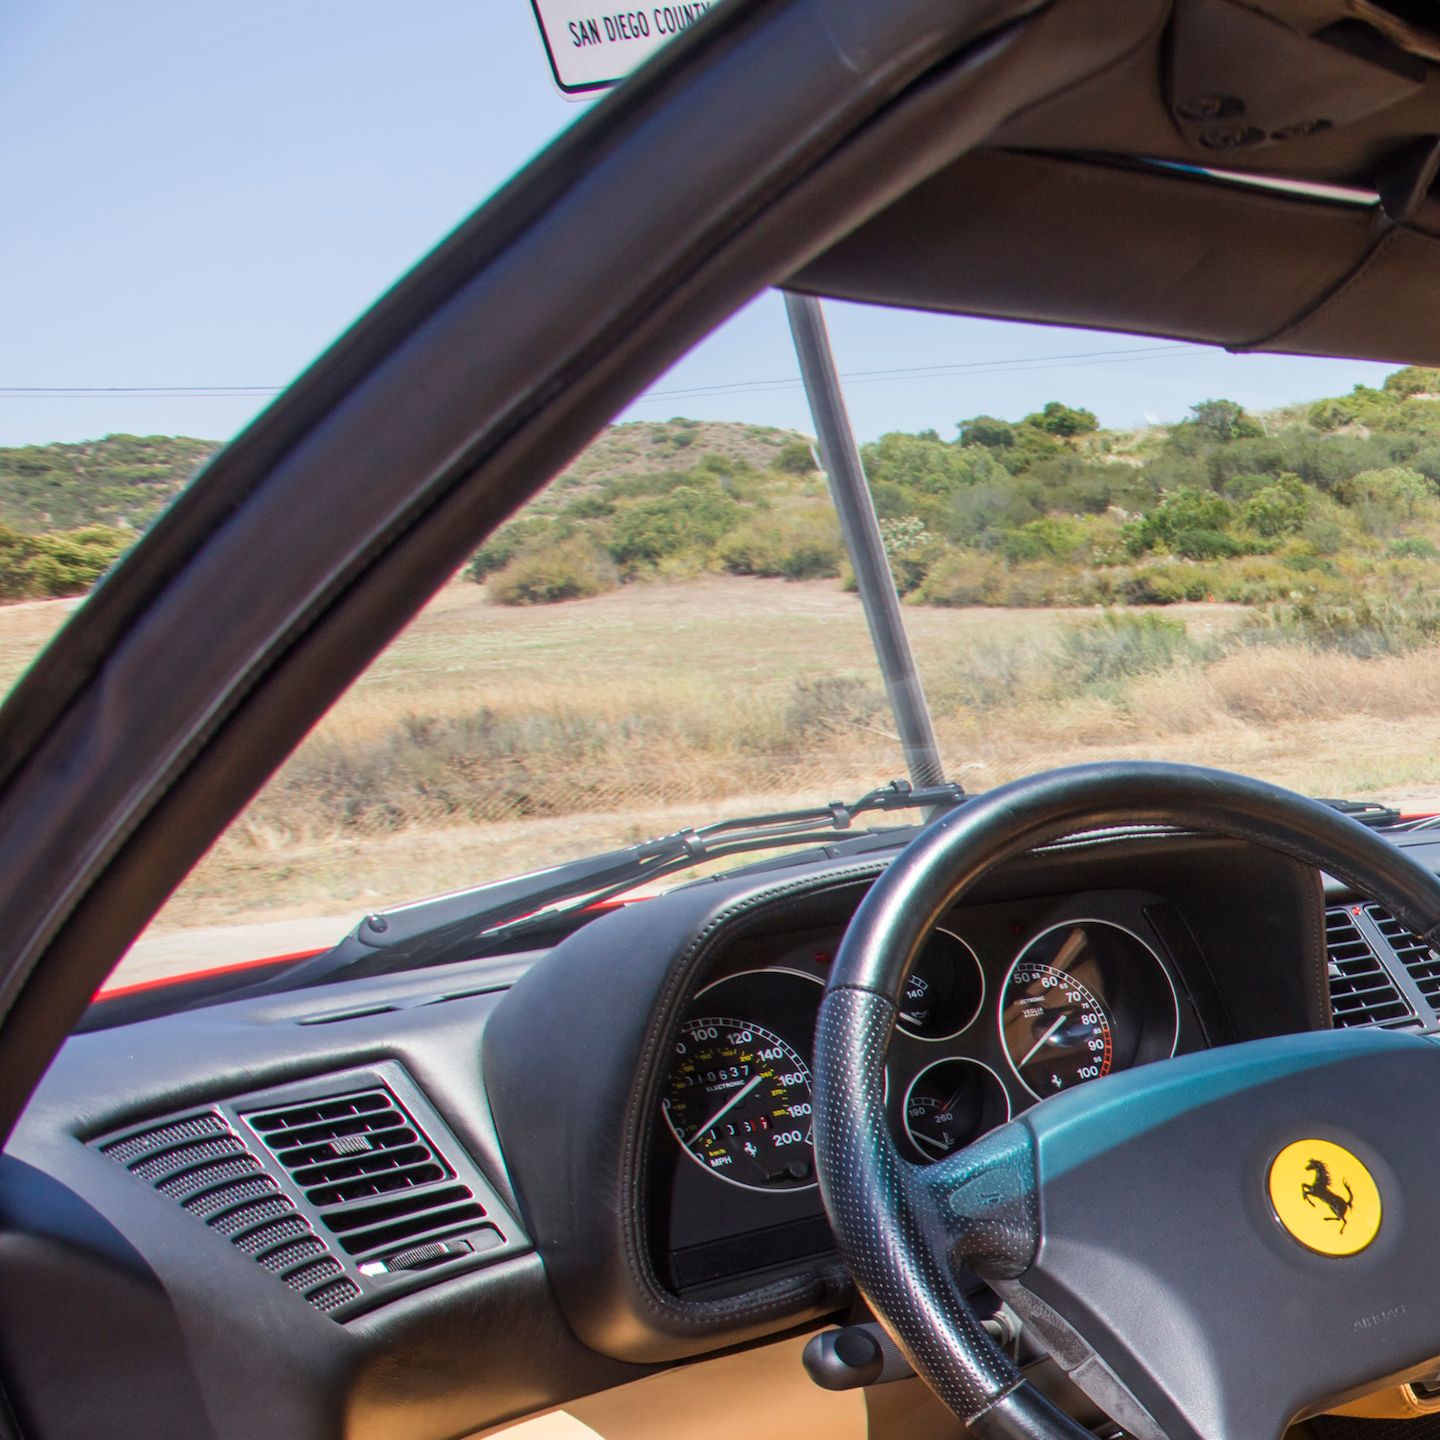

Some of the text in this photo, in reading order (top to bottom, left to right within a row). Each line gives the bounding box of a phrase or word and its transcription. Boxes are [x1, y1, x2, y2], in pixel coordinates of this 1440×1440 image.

[569, 18, 601, 47] SAN
[603, 11, 650, 42] DIEGO
[1041, 976, 1058, 988] 60
[906, 988, 924, 999] 140
[1065, 991, 1081, 1003] 70
[1081, 1013, 1098, 1025] 80
[691, 1027, 719, 1042] 100
[726, 1030, 752, 1046] 120
[1087, 1039, 1104, 1051] 90
[757, 1047, 784, 1062] 140
[779, 1072, 803, 1087] 160
[1077, 1066, 1099, 1079] 100
[787, 1103, 812, 1118] 180
[773, 1130, 802, 1147] 200
[710, 1156, 732, 1168] MPH
